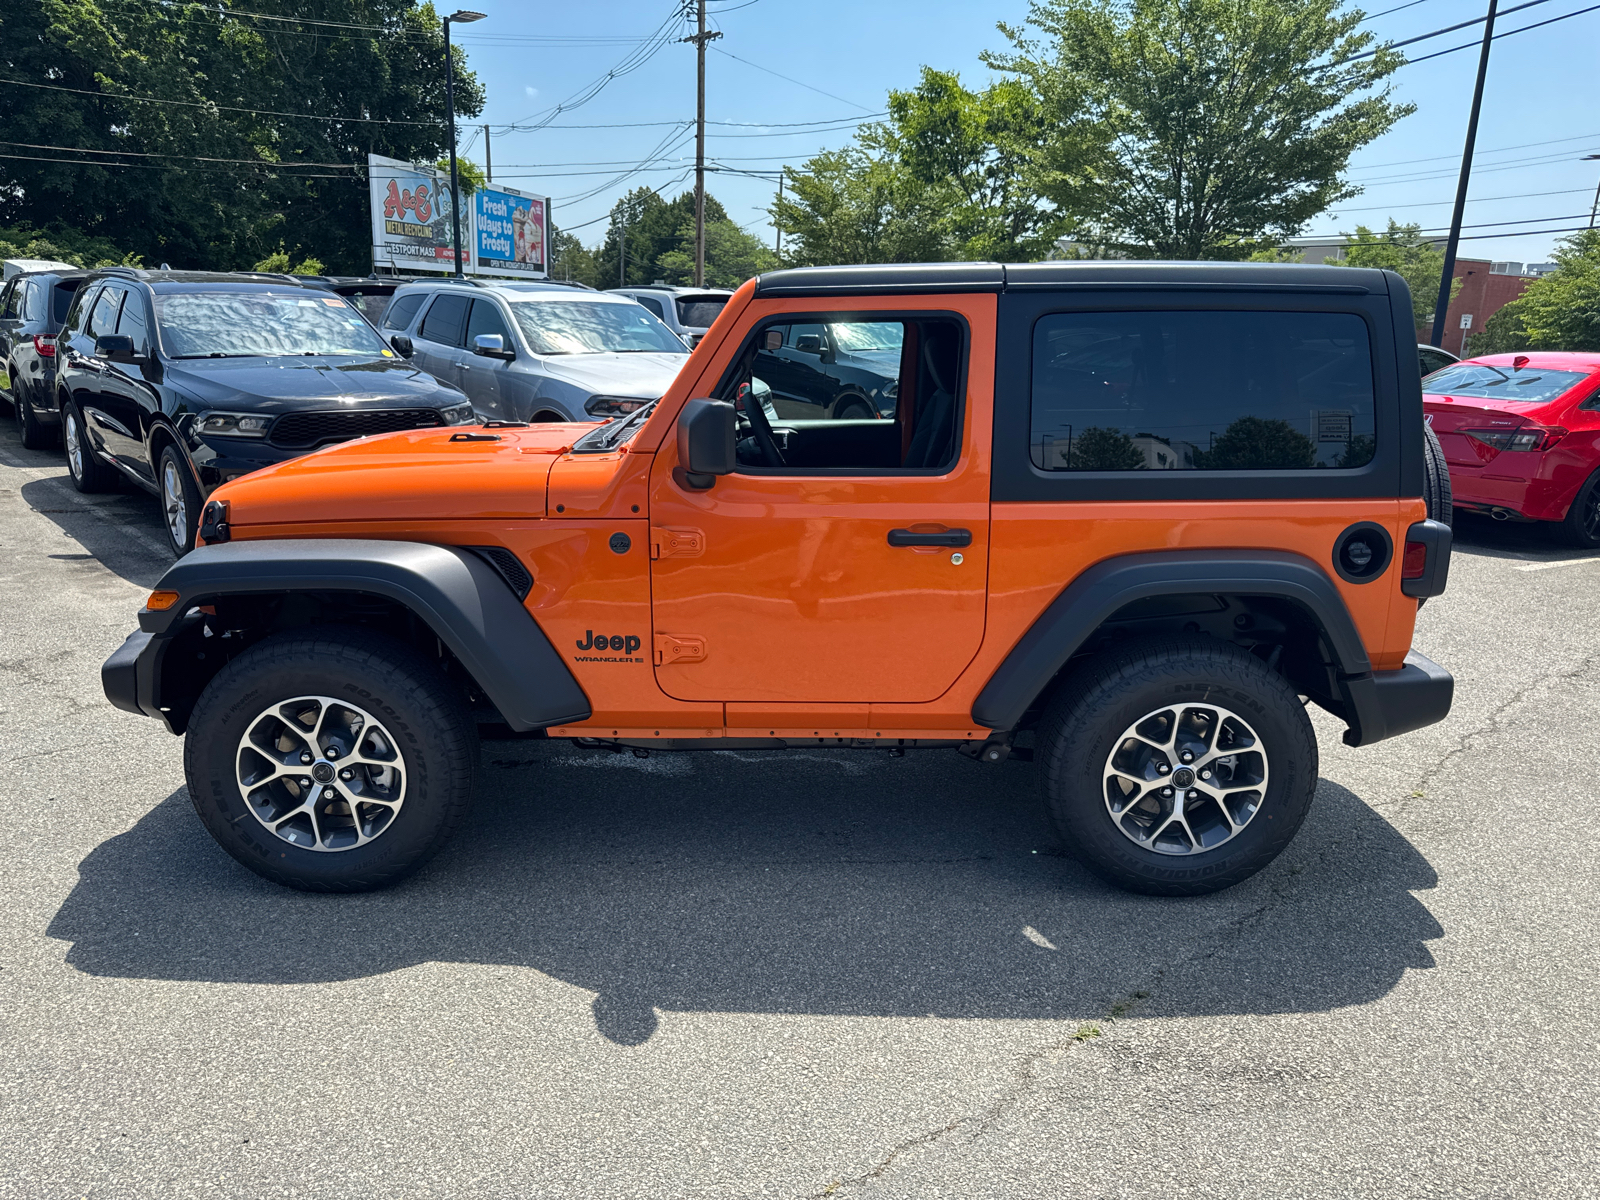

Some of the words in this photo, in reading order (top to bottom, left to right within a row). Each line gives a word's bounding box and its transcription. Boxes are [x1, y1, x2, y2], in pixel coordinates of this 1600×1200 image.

[384, 178, 432, 223] A&E
[483, 196, 507, 217] Fresh
[386, 221, 404, 235] METAL
[405, 224, 433, 238] RECYCLING
[478, 213, 502, 237] Ways
[503, 219, 513, 235] to
[385, 242, 419, 256] WESTPORT
[420, 246, 436, 257] MASS
[481, 233, 511, 257] Frosty
[490, 260, 499, 268] OPEN
[576, 630, 641, 655] Jeep
[221, 689, 258, 725] All-Weather
[1174, 683, 1265, 714] NEXEN
[343, 682, 418, 744] ROADIAN
[1084, 734, 1103, 777] 245/75R17
[1283, 760, 1295, 808] All-Weather
[210, 779, 270, 858] NEXEN
[1141, 860, 1228, 880] ROADIAN
